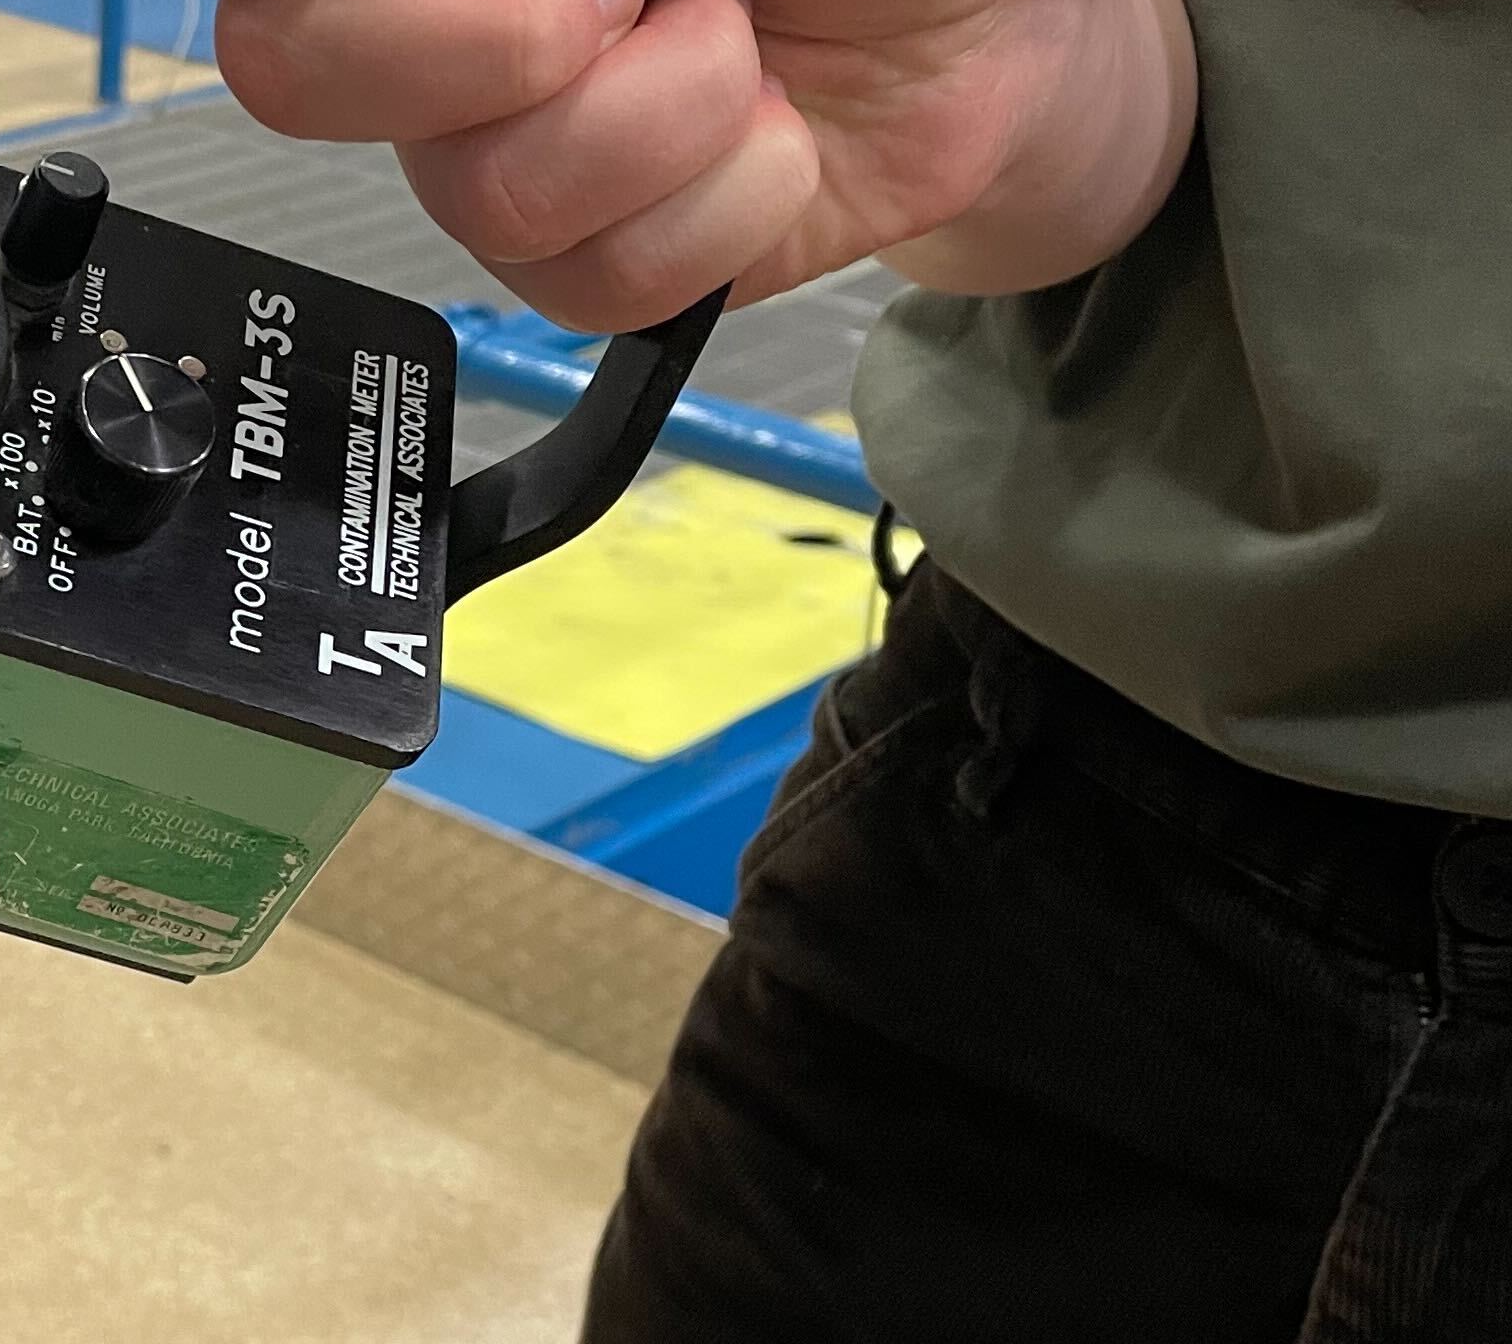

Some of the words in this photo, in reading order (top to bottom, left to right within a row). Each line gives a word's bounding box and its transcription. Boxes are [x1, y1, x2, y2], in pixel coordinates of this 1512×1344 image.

[78, 263, 106, 335] VOLUME
[230, 288, 296, 482] TBM-3S
[351, 350, 381, 419] METER
[397, 361, 429, 482] ASSOCIATES
[337, 422, 376, 587] CONTAMINATION
[389, 492, 424, 601] TECHNICAL
[47, 537, 77, 592] OFF
[228, 511, 274, 655] model
